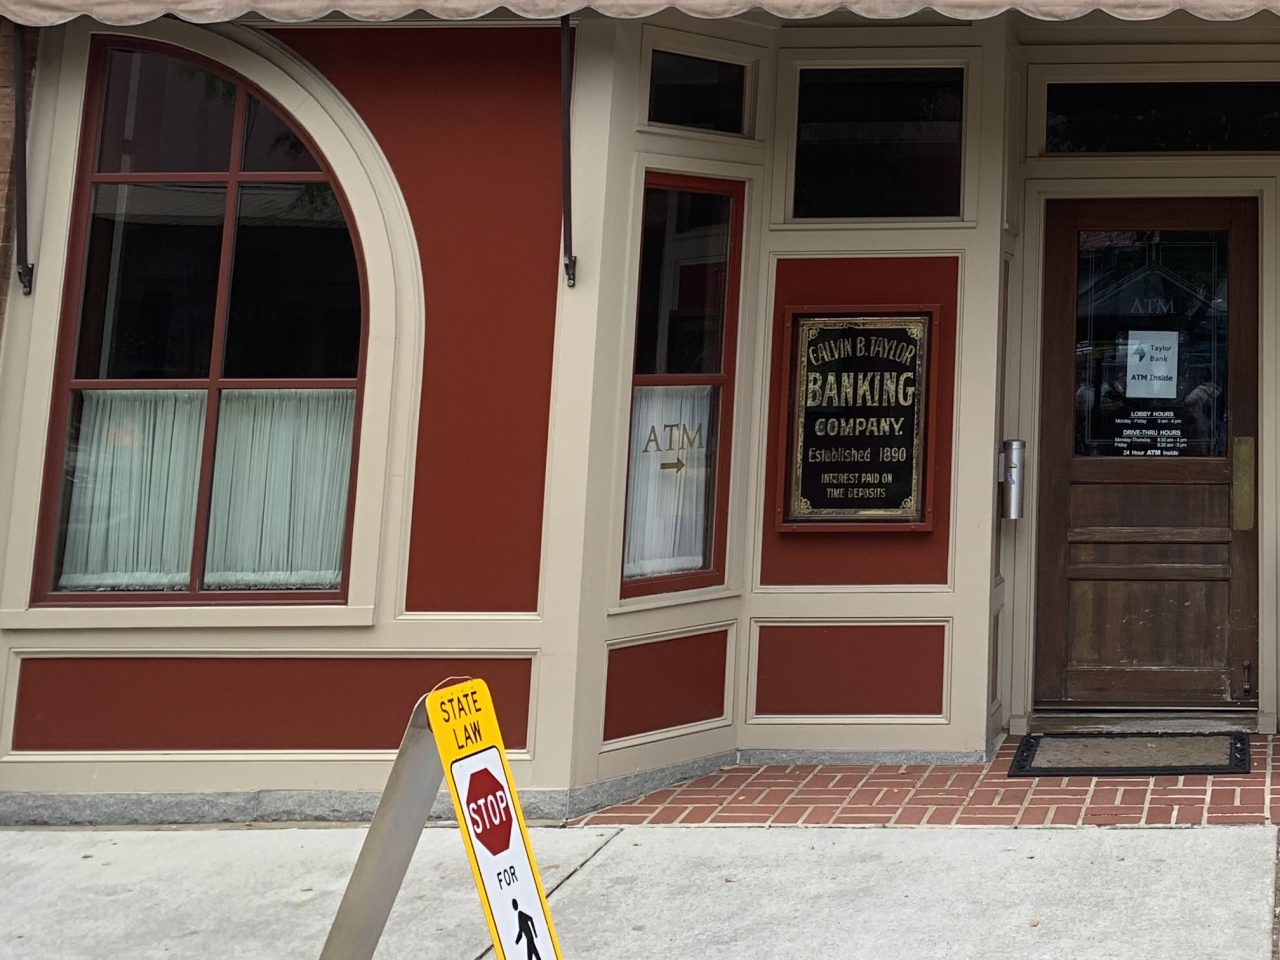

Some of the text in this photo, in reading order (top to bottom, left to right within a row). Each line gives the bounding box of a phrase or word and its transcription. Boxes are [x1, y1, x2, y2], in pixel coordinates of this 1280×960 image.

[1130, 298, 1176, 314] ATM
[808, 336, 916, 367] CALVIN B. TAYLOR
[1149, 354, 1169, 362] Bank
[1150, 344, 1173, 353] Taylor
[1131, 373, 1174, 382] ATM Inside
[806, 371, 915, 407] BANKING
[642, 422, 705, 454] ATM
[808, 447, 907, 464] Established 1890
[821, 473, 893, 484] INTEREST PAID ON
[826, 488, 886, 498] TIME DEPOSITS
[439, 691, 482, 723] STATE
[453, 721, 483, 750] LAW
[468, 790, 507, 834] STOP
[496, 865, 518, 890] FOR
